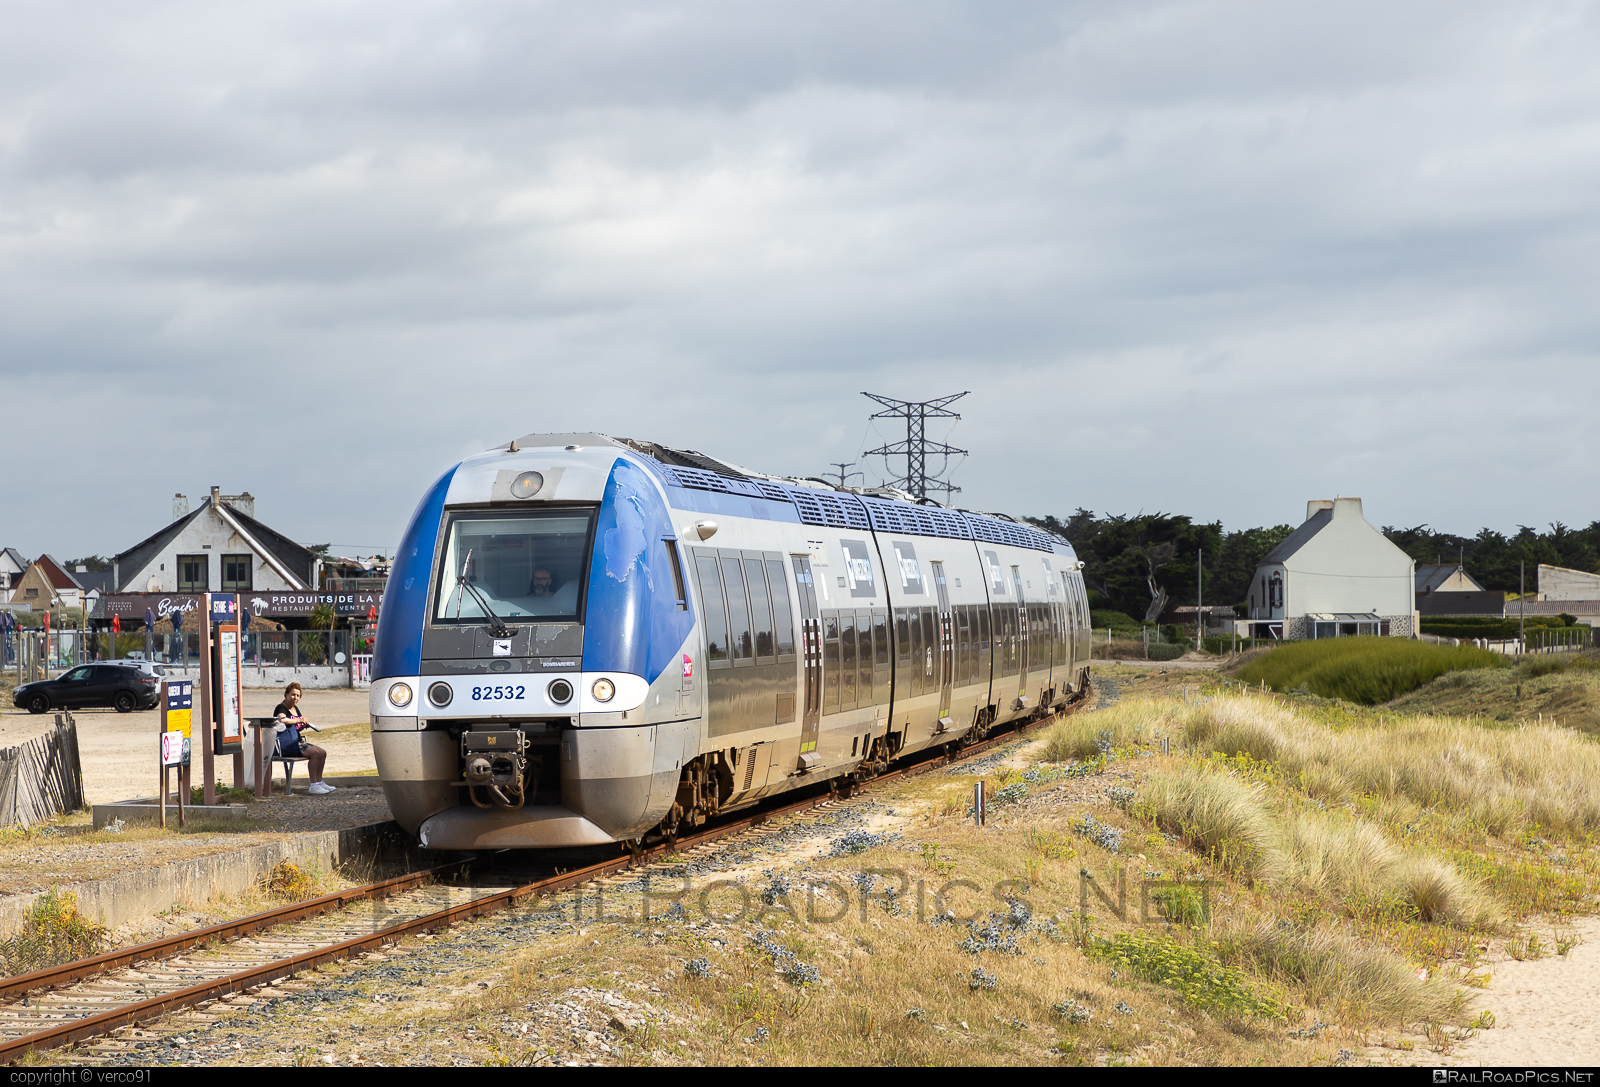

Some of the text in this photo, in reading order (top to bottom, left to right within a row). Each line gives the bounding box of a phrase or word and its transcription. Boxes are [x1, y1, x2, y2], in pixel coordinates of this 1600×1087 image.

[272, 595, 333, 604] PRODUITS
[338, 595, 354, 603] DE
[359, 595, 374, 603] LA
[158, 598, 194, 617] Beach
[262, 641, 290, 650] SAILBAGS
[471, 685, 526, 701] 82532
